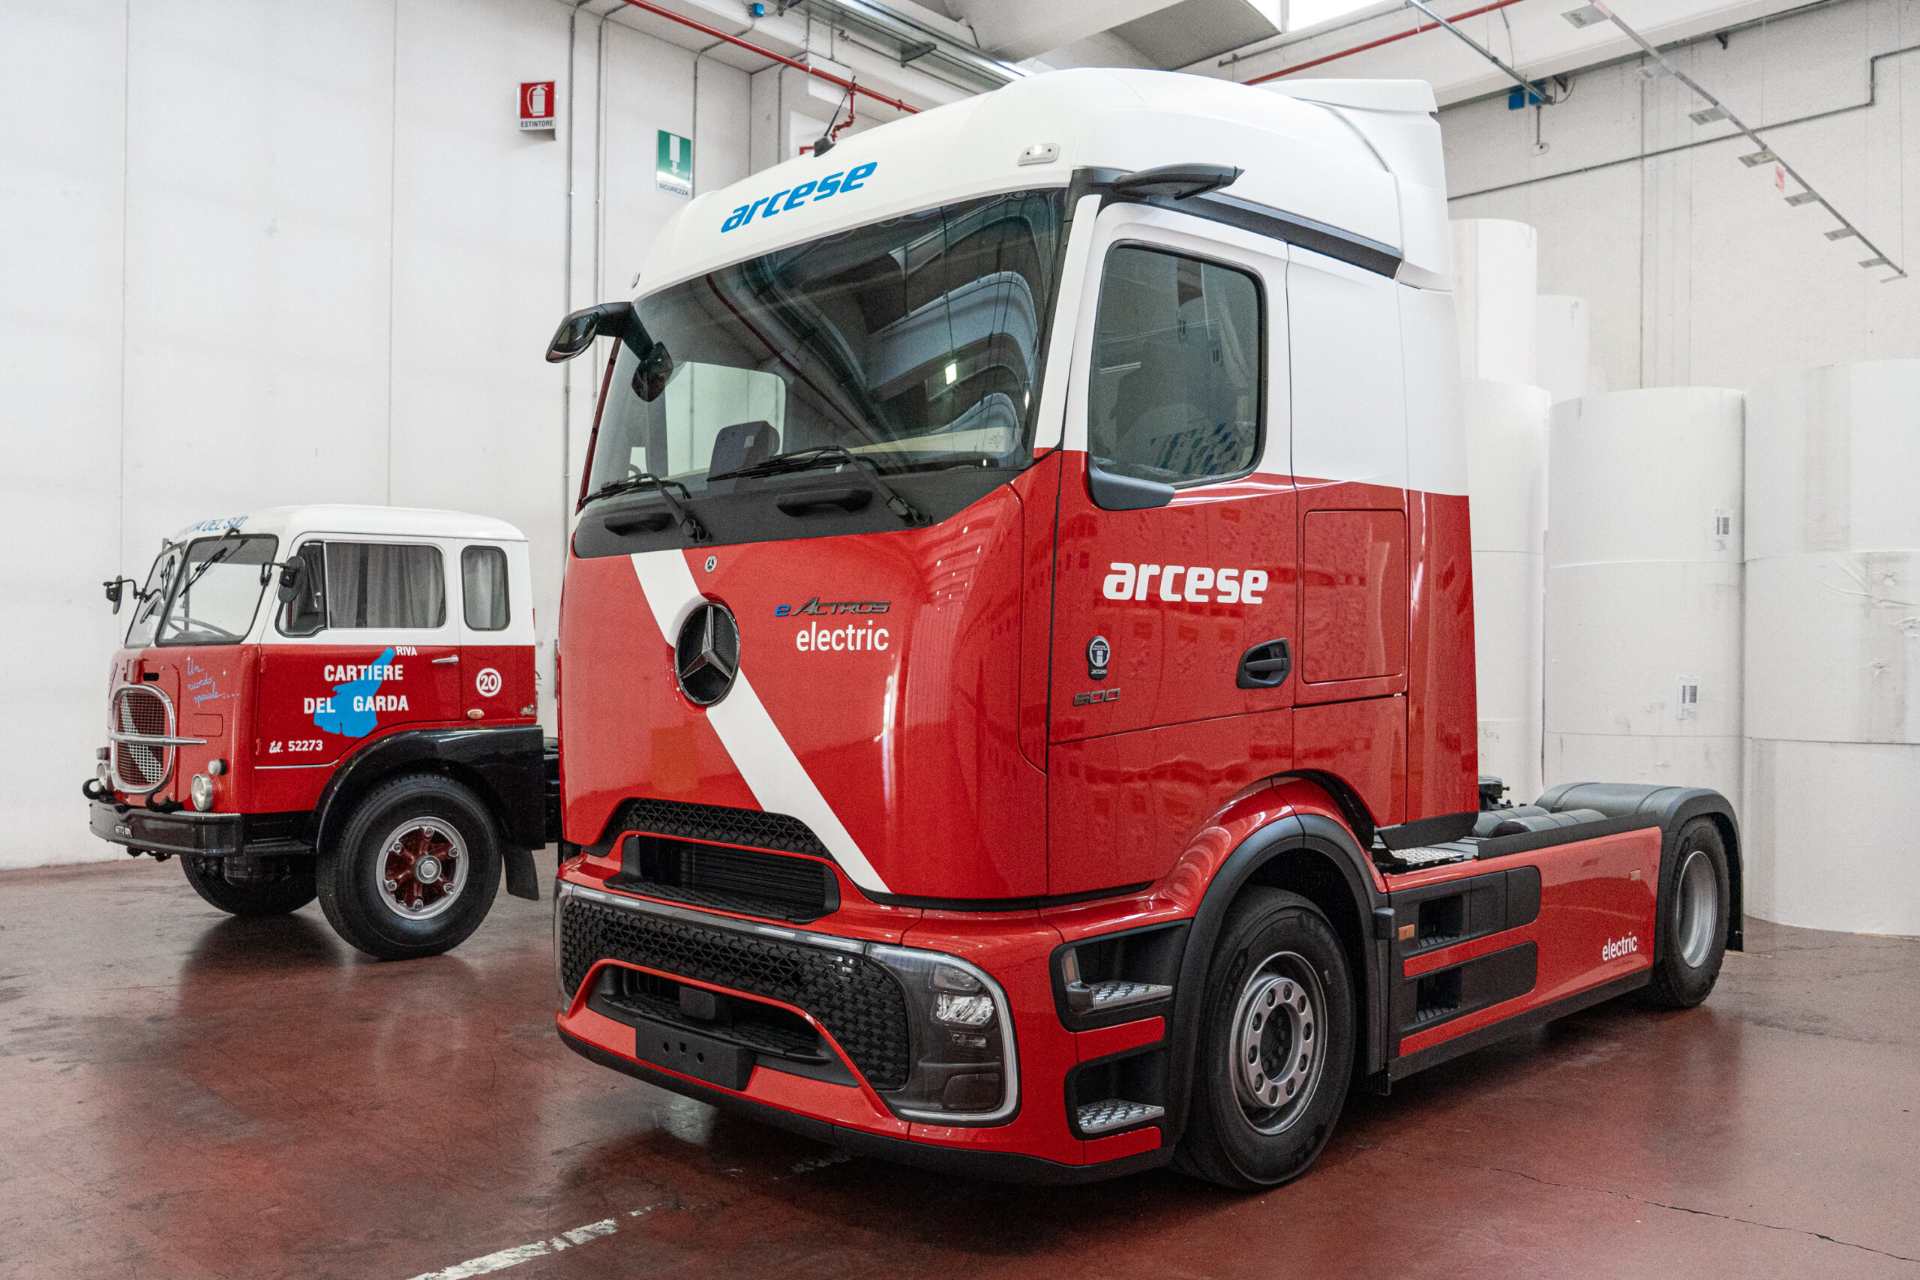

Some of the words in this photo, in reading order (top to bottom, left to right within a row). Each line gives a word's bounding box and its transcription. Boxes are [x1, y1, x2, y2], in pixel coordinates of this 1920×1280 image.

[520, 119, 553, 128] ESTINTORE
[720, 161, 878, 233] arcese
[1102, 562, 1269, 604] arcese
[796, 619, 889, 652] electric
[396, 645, 418, 657] RIVA
[323, 664, 404, 682] CARTIERE
[480, 674, 498, 691] 20
[303, 697, 336, 714] DEL
[353, 695, 409, 712] GARDA
[288, 739, 324, 752] 52273
[1602, 931, 1638, 962] electric
